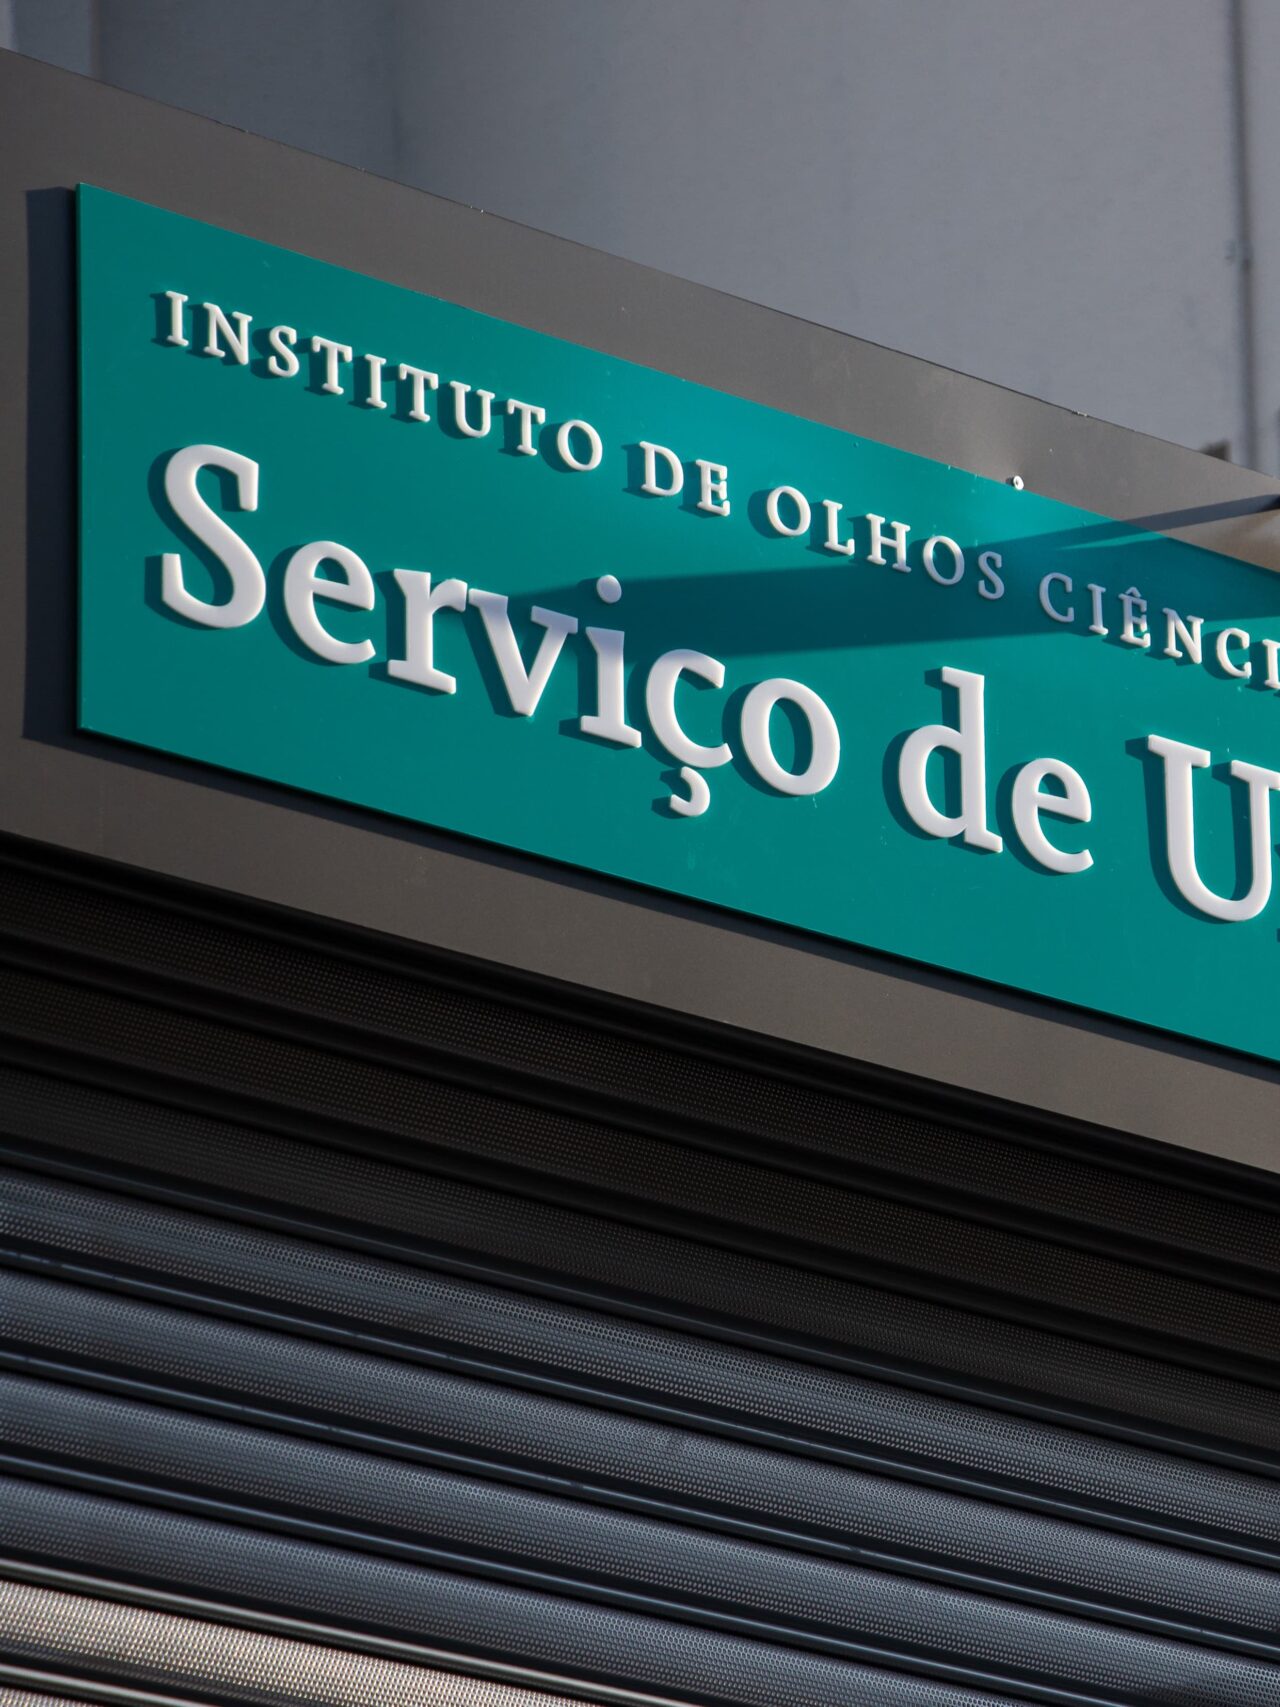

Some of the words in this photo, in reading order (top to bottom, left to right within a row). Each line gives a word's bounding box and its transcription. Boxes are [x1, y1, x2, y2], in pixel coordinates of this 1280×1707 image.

[165, 290, 602, 471] INSTITUTO
[638, 441, 731, 516] DE
[766, 486, 1004, 600] OLHOS
[162, 444, 840, 817] Serviço
[899, 666, 1094, 873] de
